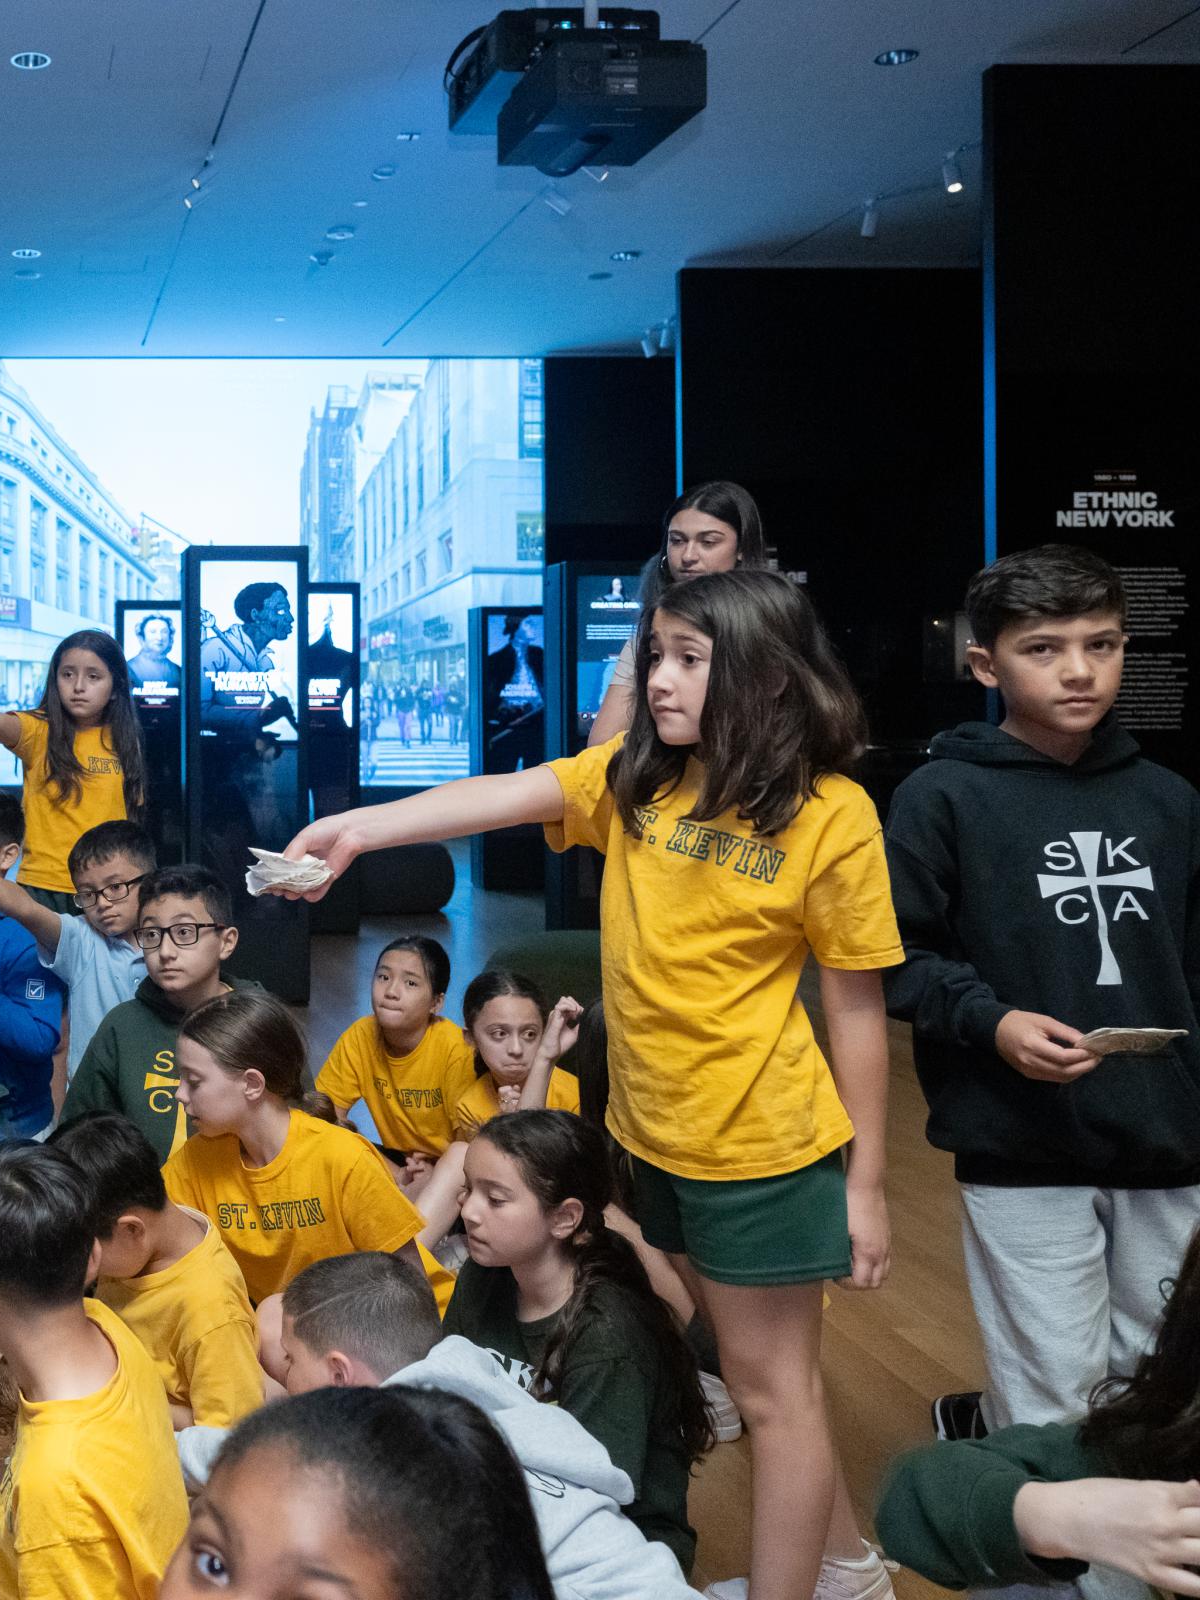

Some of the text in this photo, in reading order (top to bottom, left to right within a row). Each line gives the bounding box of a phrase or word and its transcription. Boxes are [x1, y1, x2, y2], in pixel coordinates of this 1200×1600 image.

[1073, 491, 1158, 509] ETHNIC
[1056, 510, 1175, 527] NEW YORK
[88, 756, 119, 775] KEV
[666, 820, 786, 885] KEVIN
[1043, 836, 1141, 871] S K
[1055, 891, 1149, 925] C A
[152, 1050, 175, 1073] S
[148, 1089, 173, 1113] C
[218, 1198, 326, 1231] ST. KEVIN
